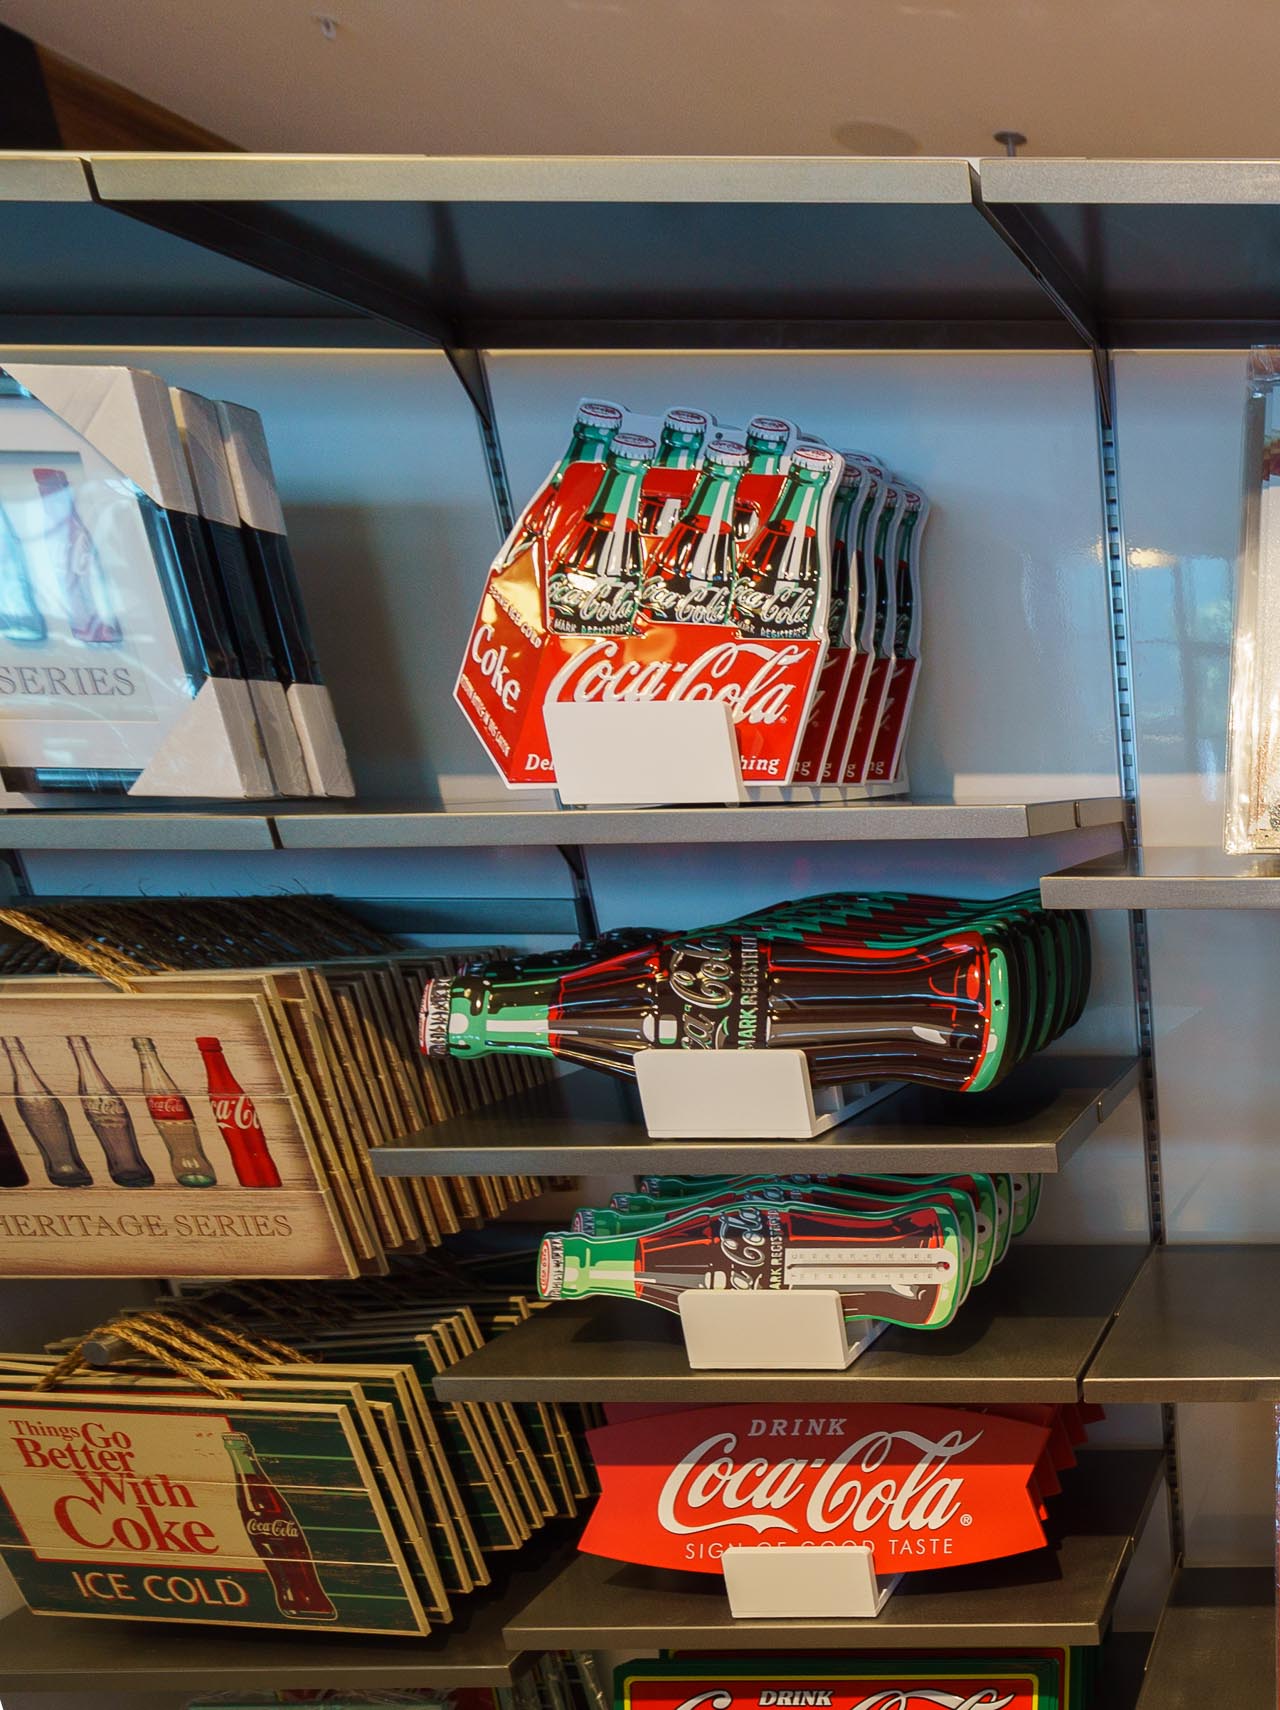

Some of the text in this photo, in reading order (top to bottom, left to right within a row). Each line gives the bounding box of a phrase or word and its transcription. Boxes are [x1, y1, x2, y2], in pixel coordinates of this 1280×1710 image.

[0, 666, 135, 696] SERIES
[471, 624, 520, 711] Coke
[546, 640, 813, 727] Coca-Cola
[173, 1214, 294, 1238] SERIES
[9, 1419, 132, 1451] Things Go
[747, 1418, 848, 1438] DRINK
[12, 1436, 136, 1474] Better
[73, 1469, 199, 1510] With
[657, 1429, 984, 1536] Coca-Cola
[53, 1494, 221, 1555] Coke
[245, 1518, 300, 1539] Coca-Cola
[889, 1538, 953, 1555] TASTE
[71, 1570, 250, 1608] ICE COLD
[758, 1689, 835, 1706] DRINK
